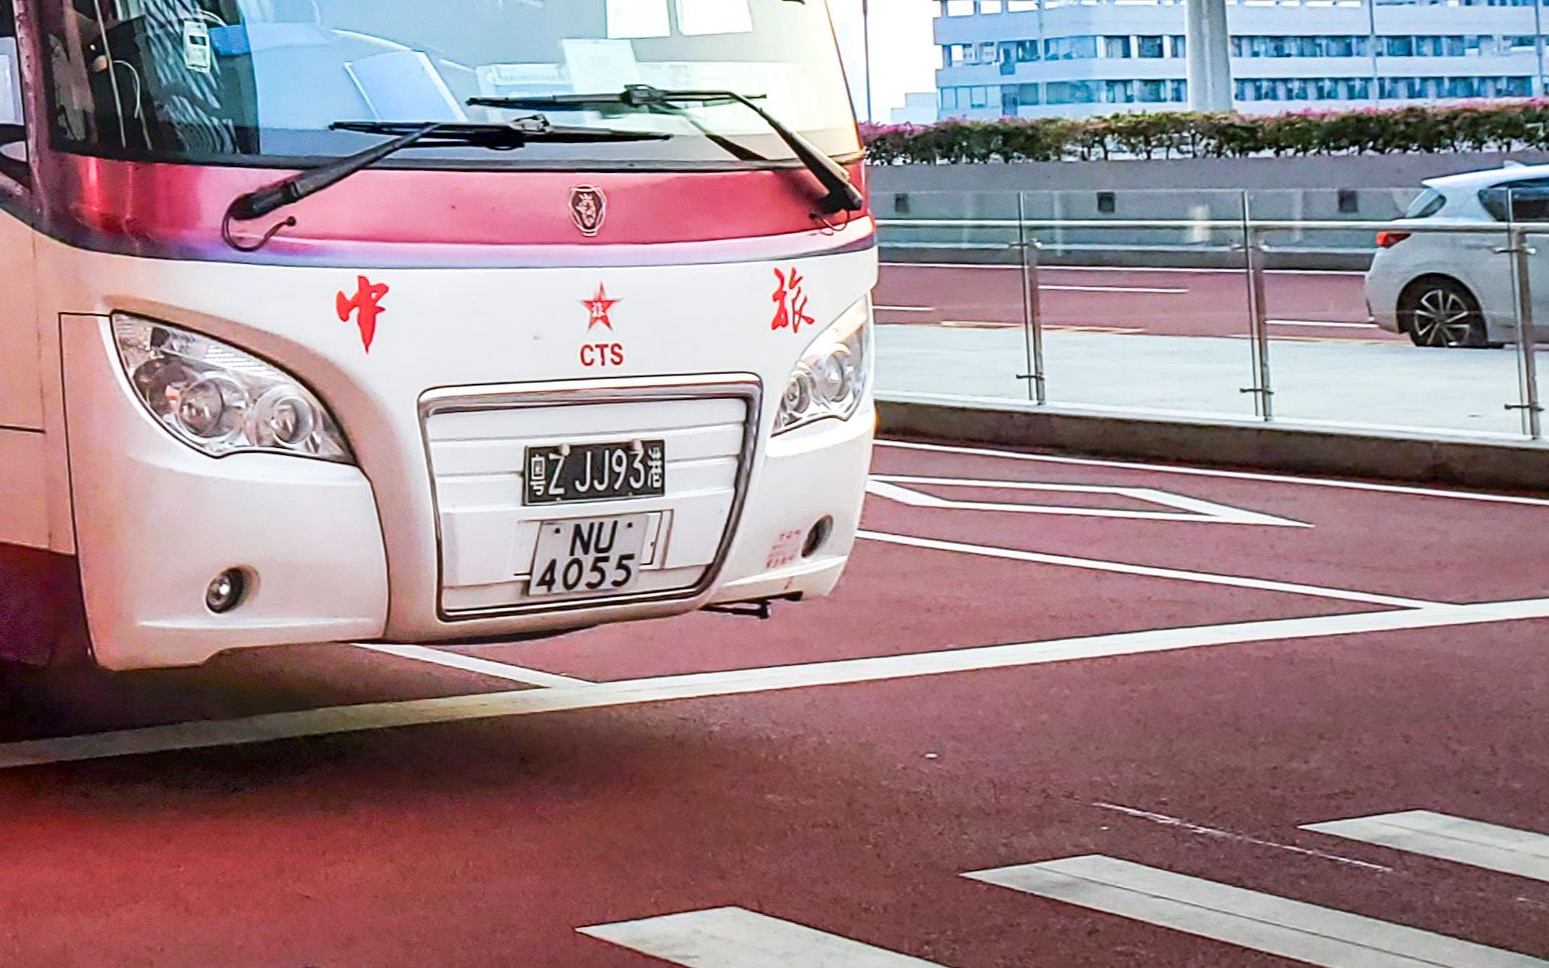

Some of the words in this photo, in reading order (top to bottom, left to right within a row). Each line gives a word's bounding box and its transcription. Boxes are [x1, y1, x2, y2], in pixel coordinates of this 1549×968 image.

[336, 275, 389, 354] 中
[771, 267, 815, 334] 旅
[580, 343, 624, 367] CTS
[569, 520, 619, 557] NU
[536, 553, 636, 592] 4055
